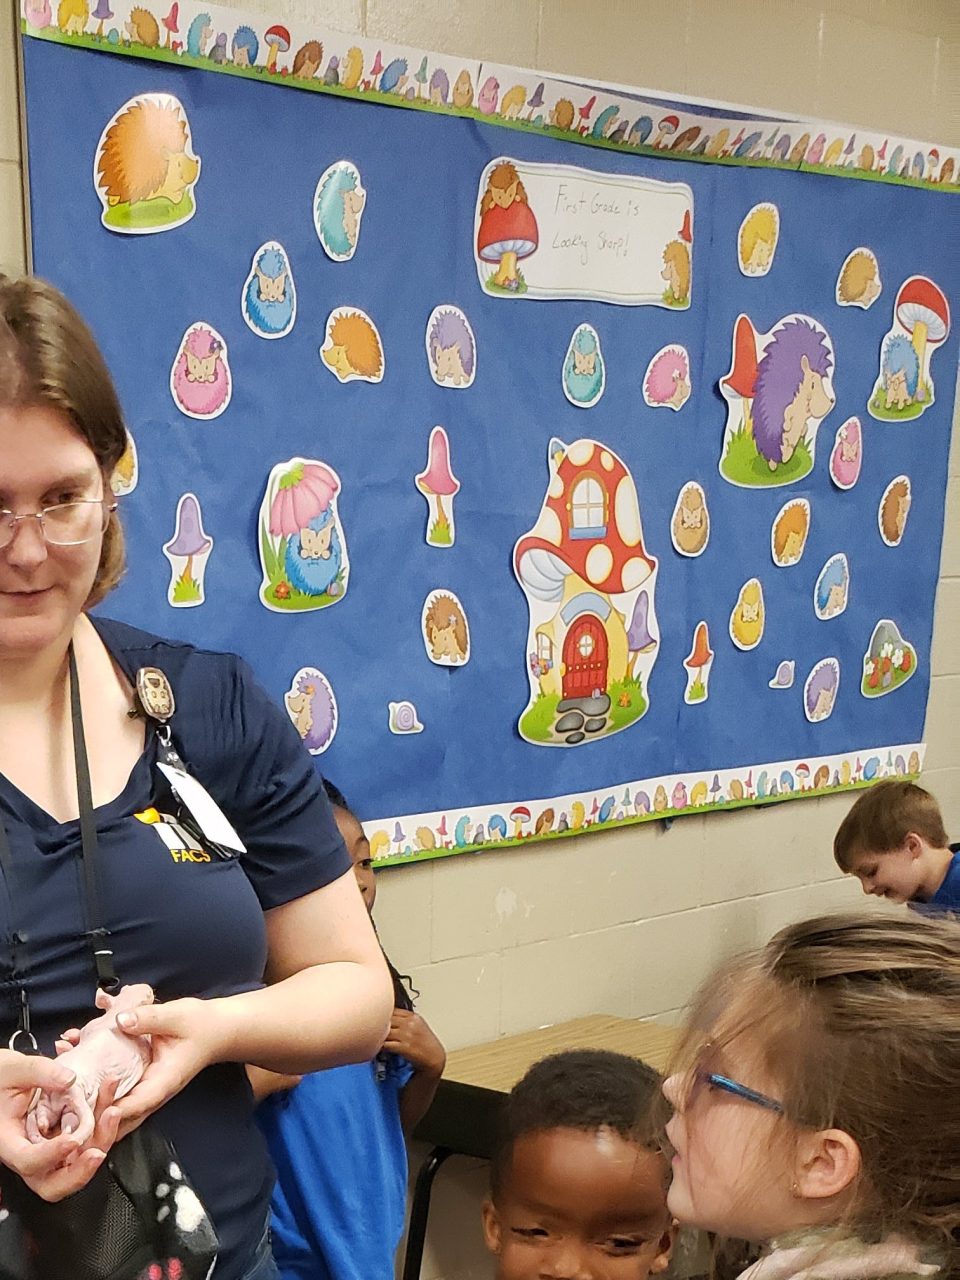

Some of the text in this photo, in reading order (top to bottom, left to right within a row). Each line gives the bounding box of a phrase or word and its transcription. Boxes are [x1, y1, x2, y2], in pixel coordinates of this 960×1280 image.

[555, 184, 640, 217] First Grade is
[169, 849, 212, 863] FACS
